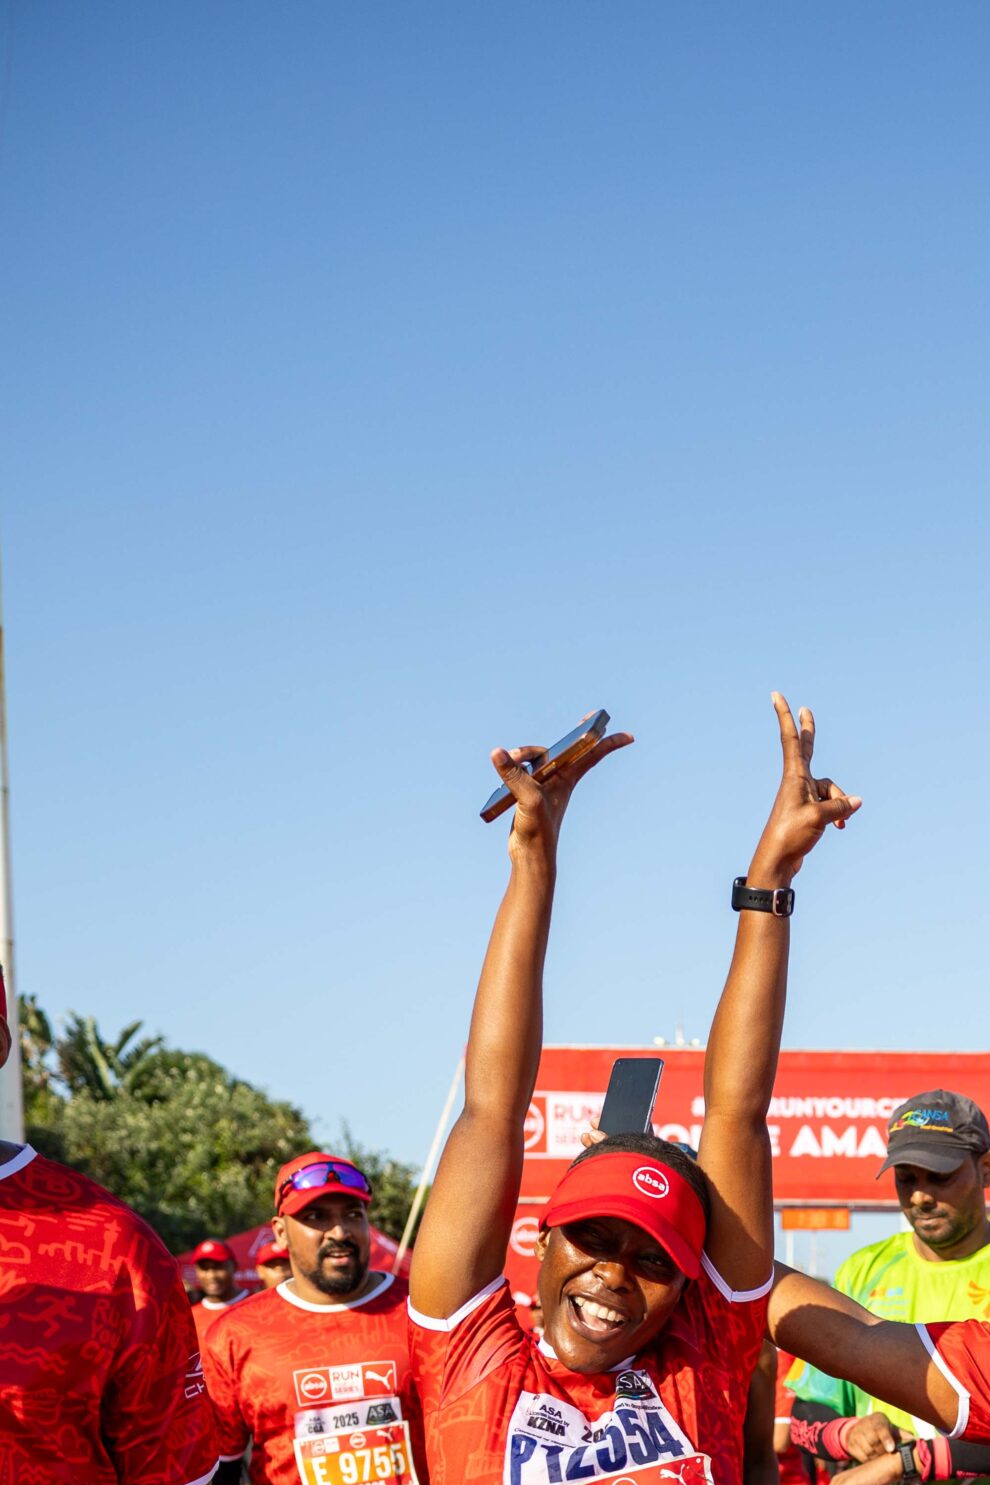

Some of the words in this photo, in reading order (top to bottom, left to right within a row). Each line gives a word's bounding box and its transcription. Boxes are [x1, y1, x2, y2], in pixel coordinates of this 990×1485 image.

[638, 1173, 665, 1191] absa
[332, 1370, 360, 1380] RUN
[370, 1403, 393, 1417] ASA
[540, 1404, 562, 1419] ASA
[333, 1412, 359, 1429] 2025
[527, 1416, 566, 1437] KZNA
[338, 1443, 406, 1485] 9755
